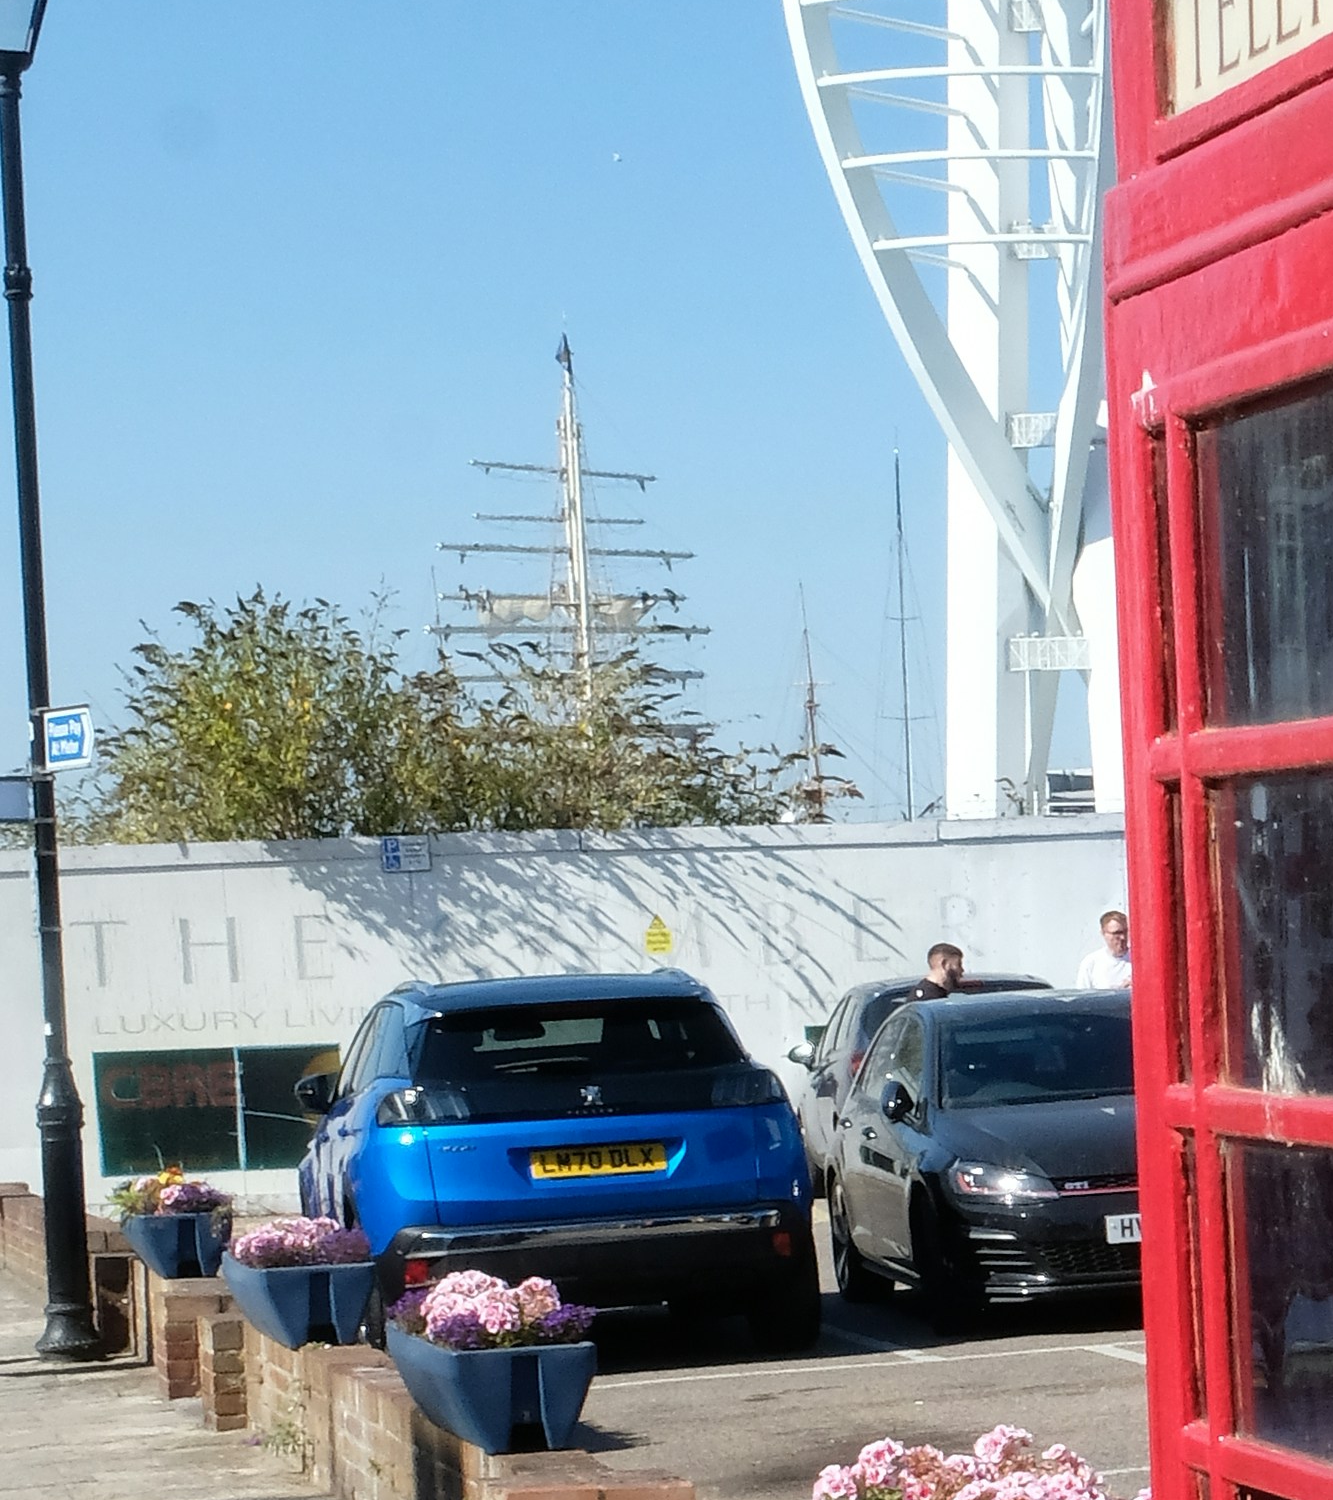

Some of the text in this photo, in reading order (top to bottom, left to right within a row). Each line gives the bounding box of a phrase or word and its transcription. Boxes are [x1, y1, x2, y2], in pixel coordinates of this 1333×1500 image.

[70, 915, 334, 987] THE
[95, 1009, 267, 1035] LUXURY
[101, 1062, 237, 1109] CBRE
[608, 1147, 655, 1168] DLX
